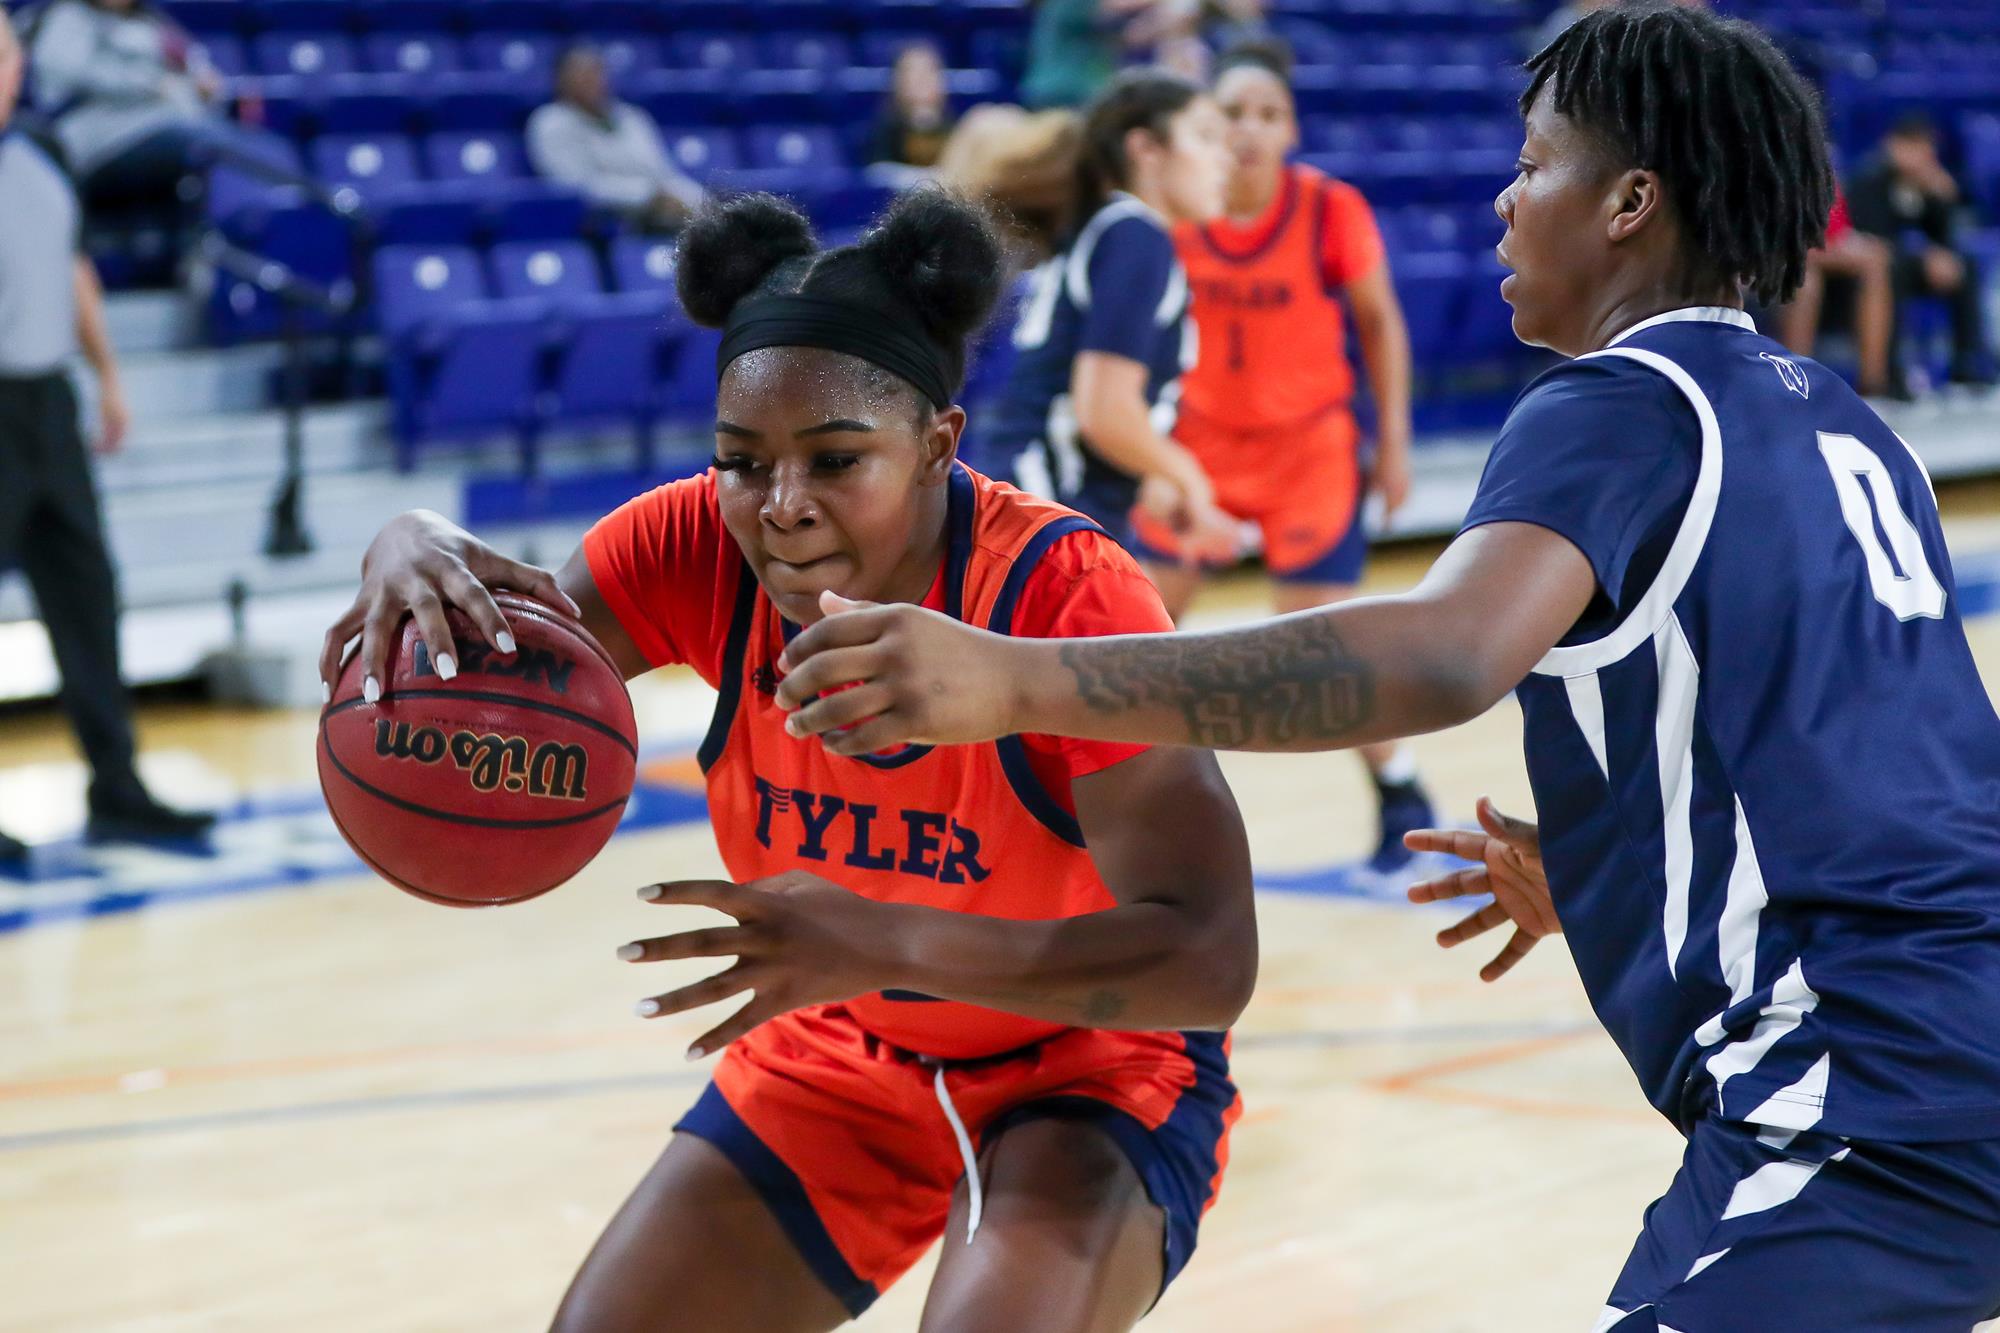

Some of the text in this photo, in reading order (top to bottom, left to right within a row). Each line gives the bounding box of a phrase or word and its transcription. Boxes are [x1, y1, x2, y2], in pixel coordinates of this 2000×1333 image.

[1815, 430, 1948, 622] 0
[375, 718, 588, 802] Wilson
[755, 775, 992, 885] TYLER
